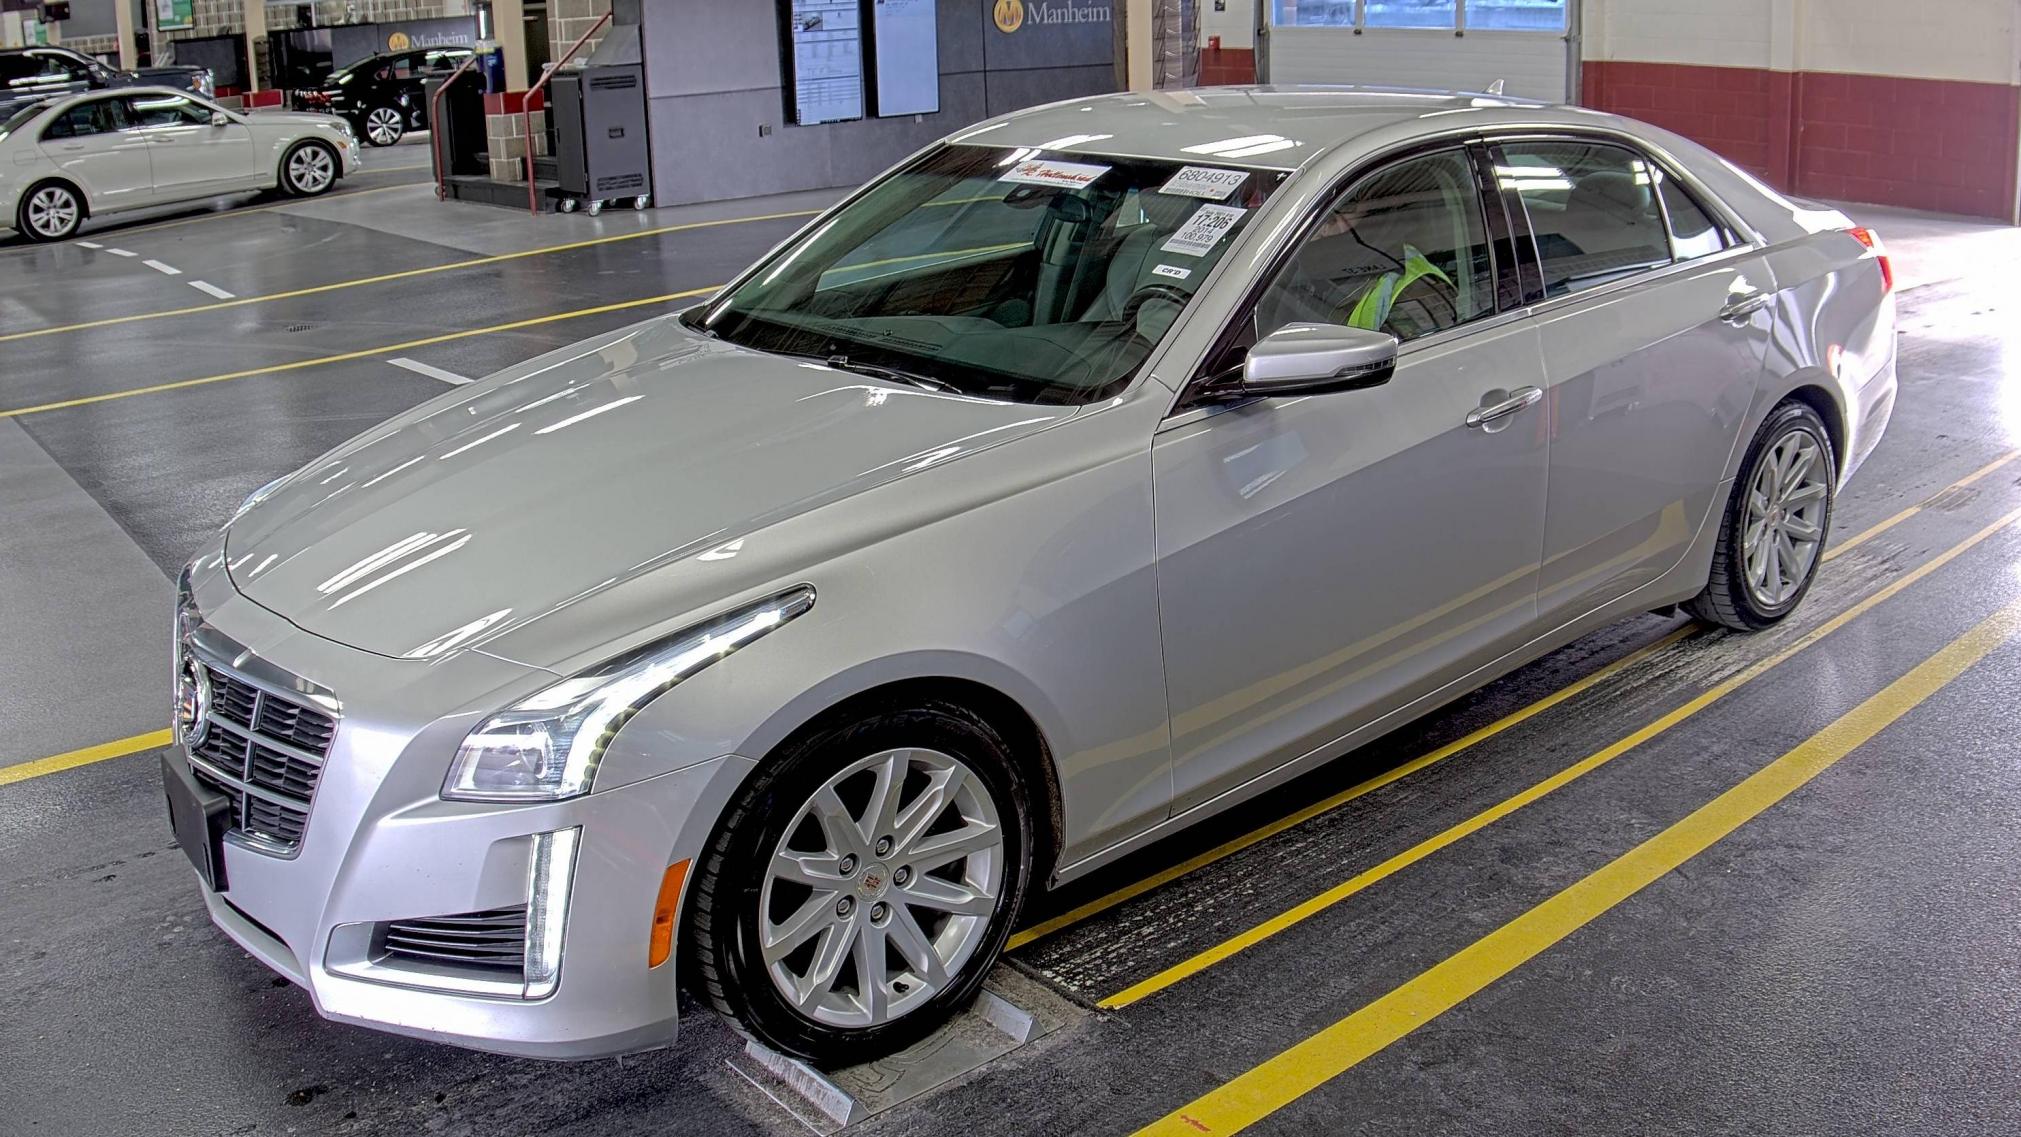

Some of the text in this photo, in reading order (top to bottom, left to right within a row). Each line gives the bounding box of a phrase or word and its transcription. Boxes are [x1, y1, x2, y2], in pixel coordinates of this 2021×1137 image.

[1027, 0, 1110, 24] Manheim
[411, 32, 468, 48] Manheim
[1179, 170, 1241, 185] 6804913
